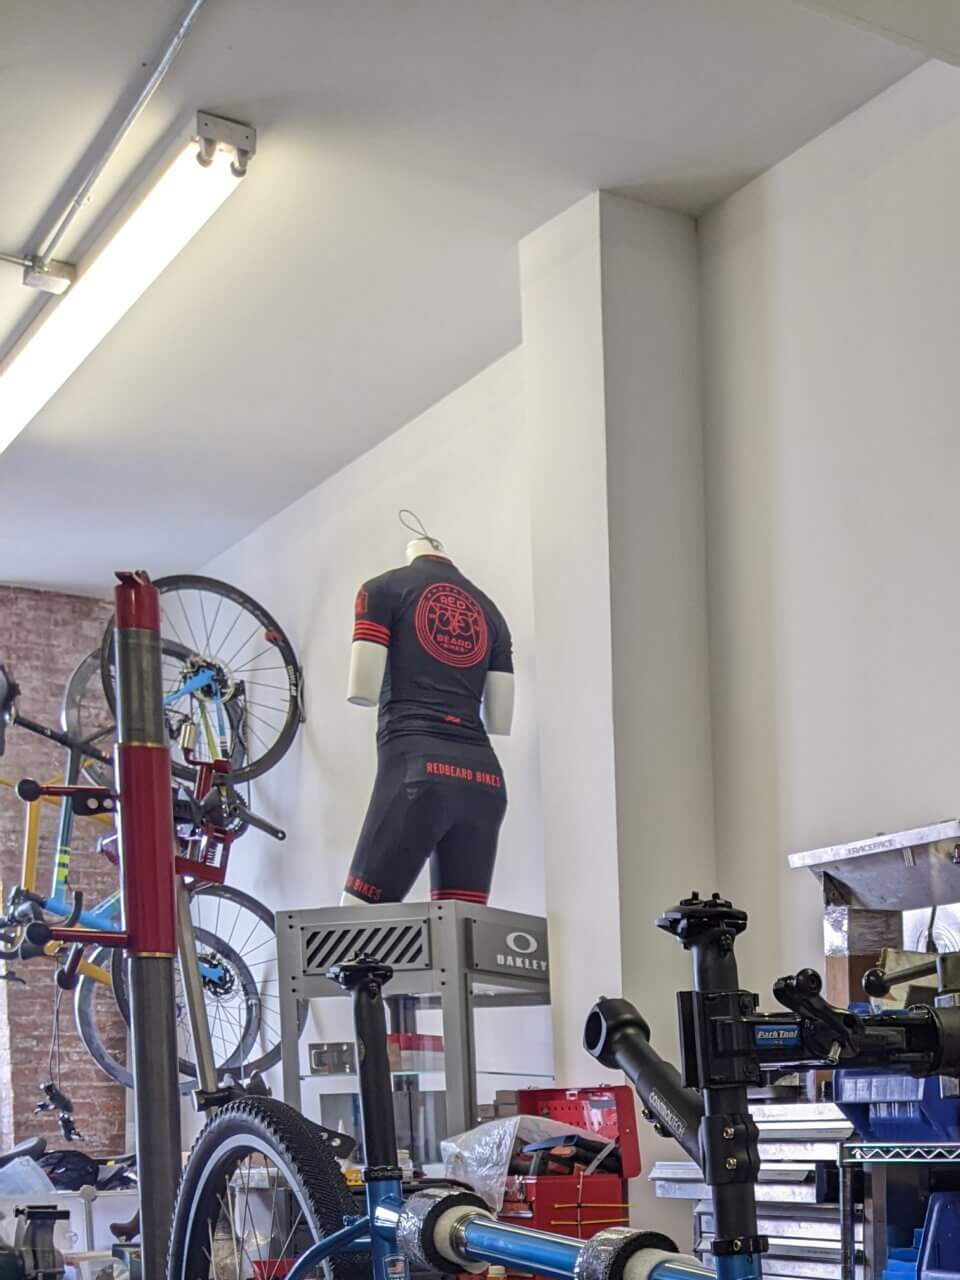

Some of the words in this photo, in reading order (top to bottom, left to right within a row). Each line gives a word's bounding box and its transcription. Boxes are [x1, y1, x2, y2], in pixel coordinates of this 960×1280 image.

[440, 596, 466, 609] RED
[425, 761, 473, 781] REDBEARD
[475, 771, 501, 788] BIKES
[496, 953, 547, 971] OAKLEY
